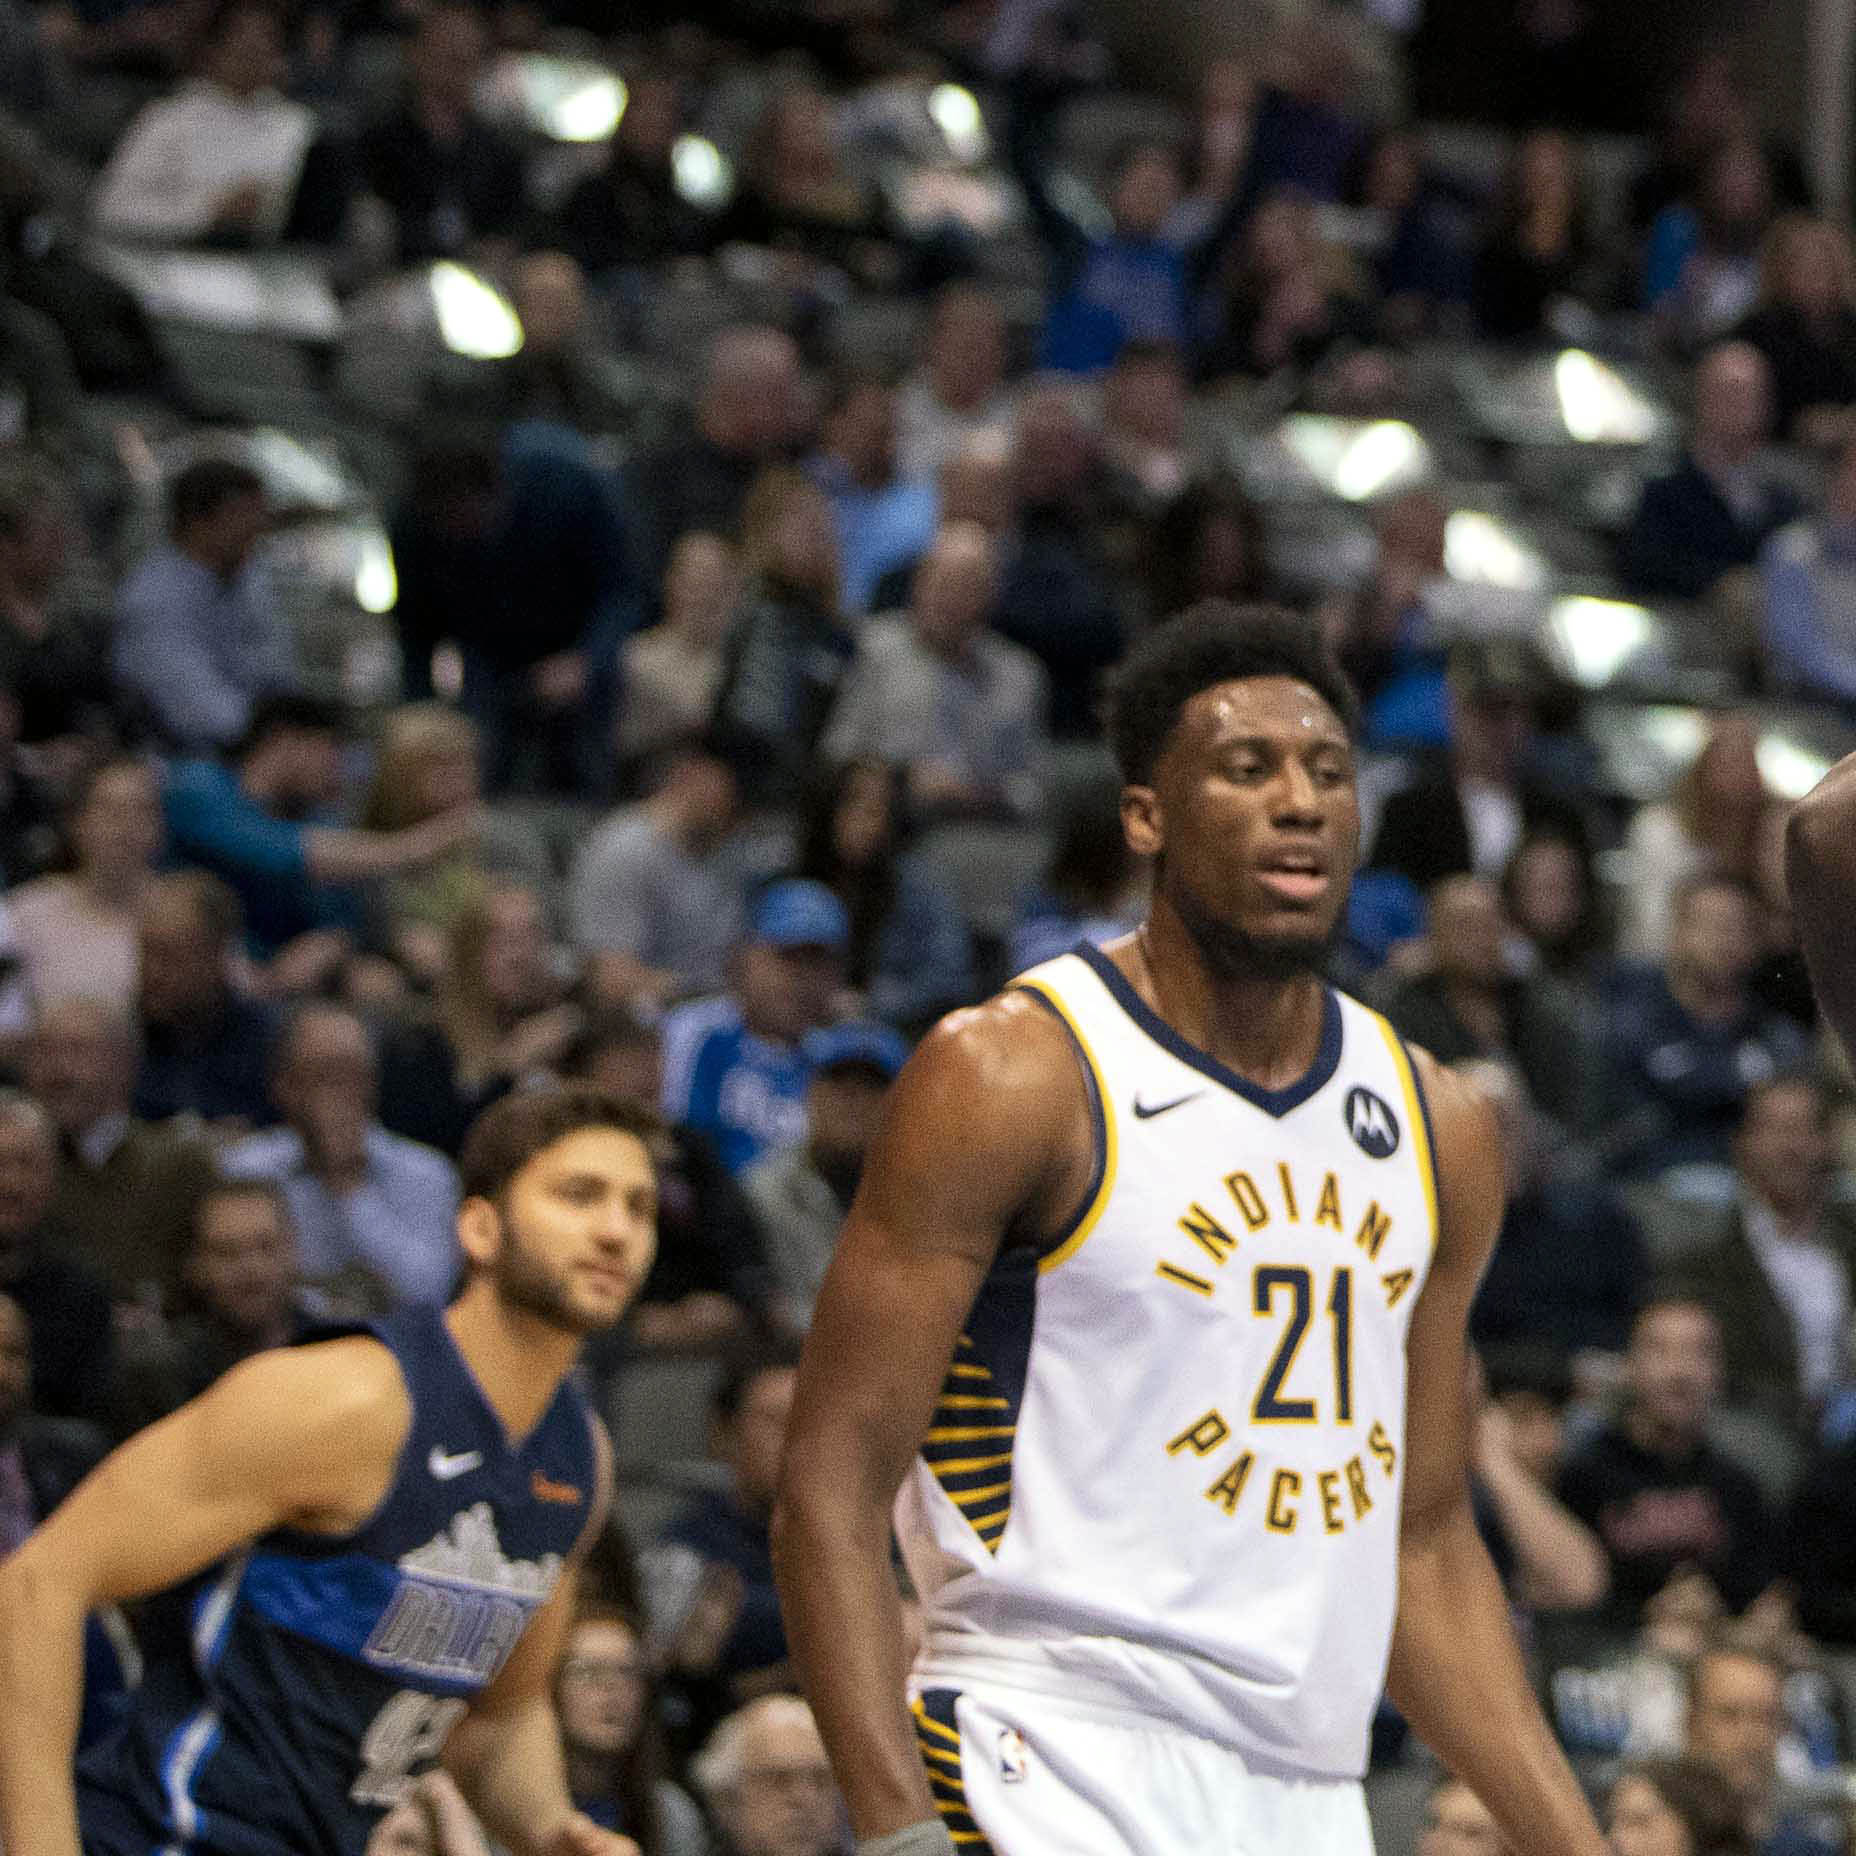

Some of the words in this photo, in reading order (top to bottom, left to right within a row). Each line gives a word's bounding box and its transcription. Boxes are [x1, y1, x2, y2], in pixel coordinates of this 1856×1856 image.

[1156, 1161, 1415, 1310] INDIANA
[1249, 1263, 1355, 1427] 21
[1165, 1407, 1397, 1536] PACERS
